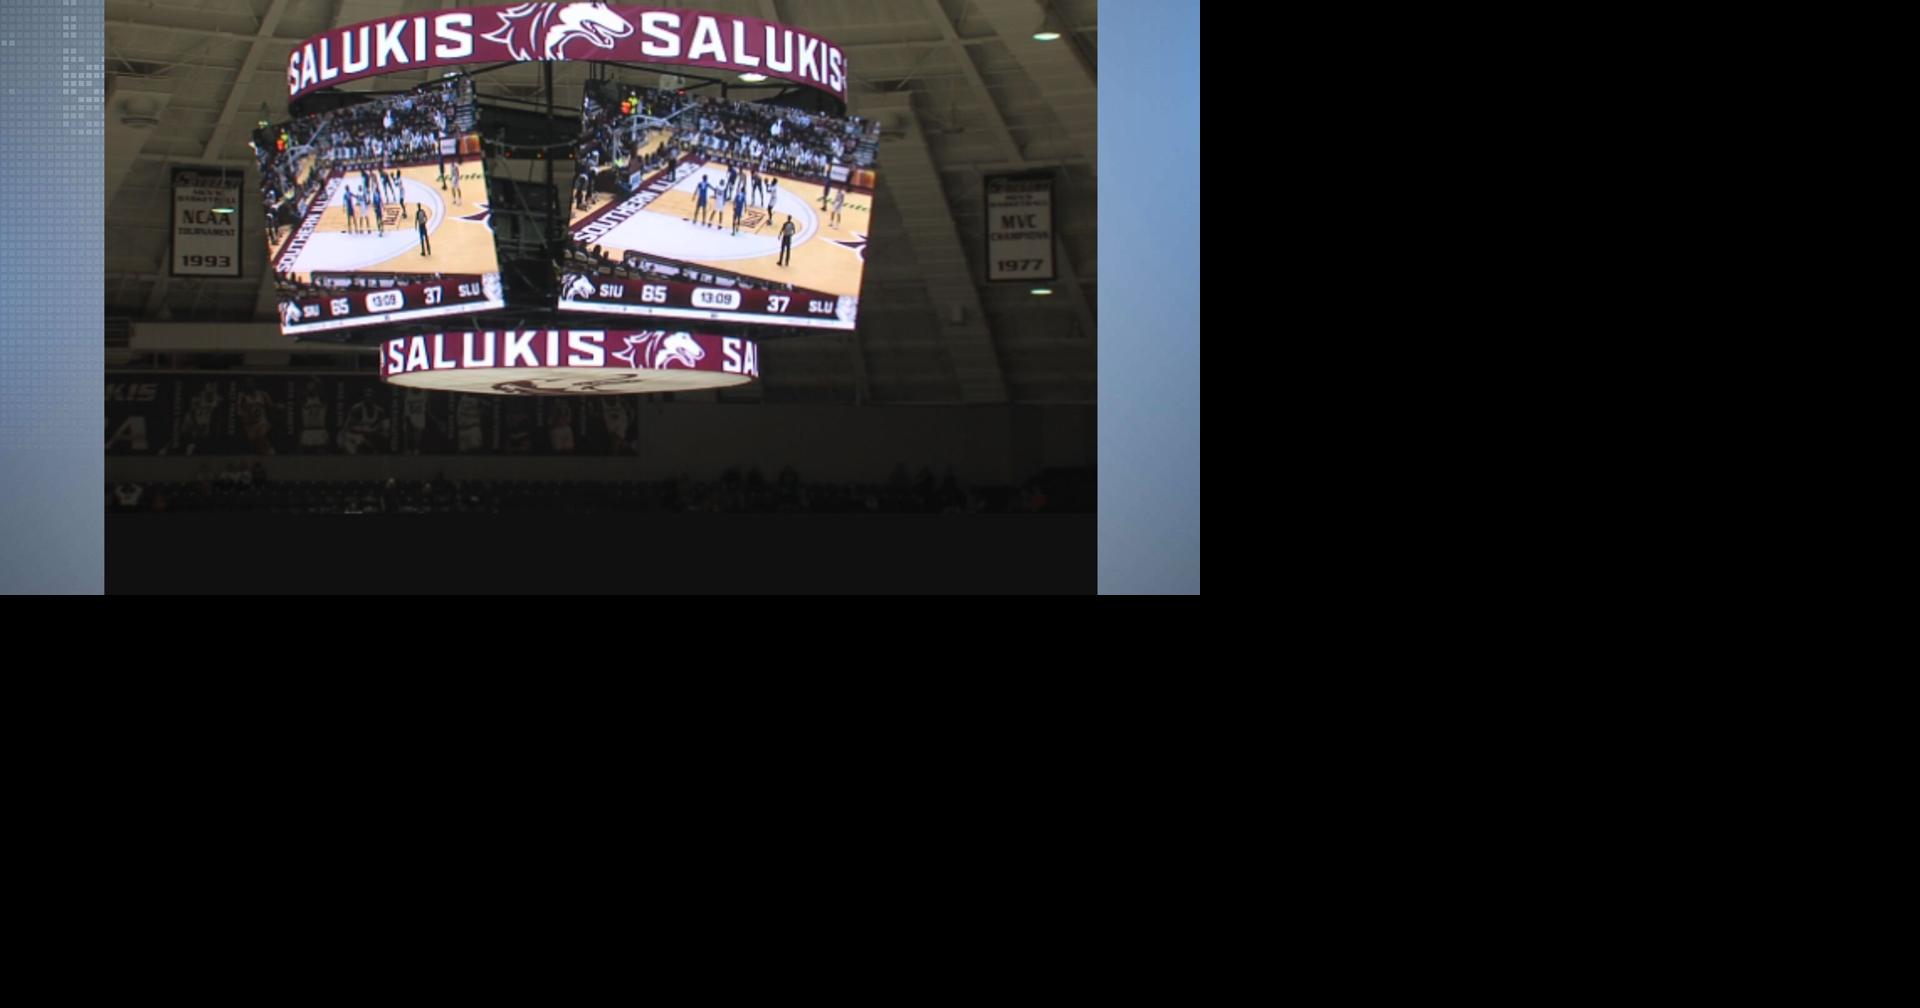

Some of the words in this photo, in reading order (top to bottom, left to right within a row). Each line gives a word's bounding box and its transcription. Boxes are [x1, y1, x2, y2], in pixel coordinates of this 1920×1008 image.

[289, 13, 473, 95] SALUKIS
[640, 11, 842, 93] SALUKIS
[183, 209, 231, 226] NCAA
[1001, 214, 1037, 229] MVC
[182, 255, 231, 268] 1993
[997, 258, 1044, 272] 1977
[423, 285, 443, 305] 37
[457, 282, 481, 298] SLU
[599, 284, 624, 298] SIU
[766, 294, 791, 313] 37
[807, 300, 834, 314] SLU
[388, 330, 606, 374] SALUKIS
